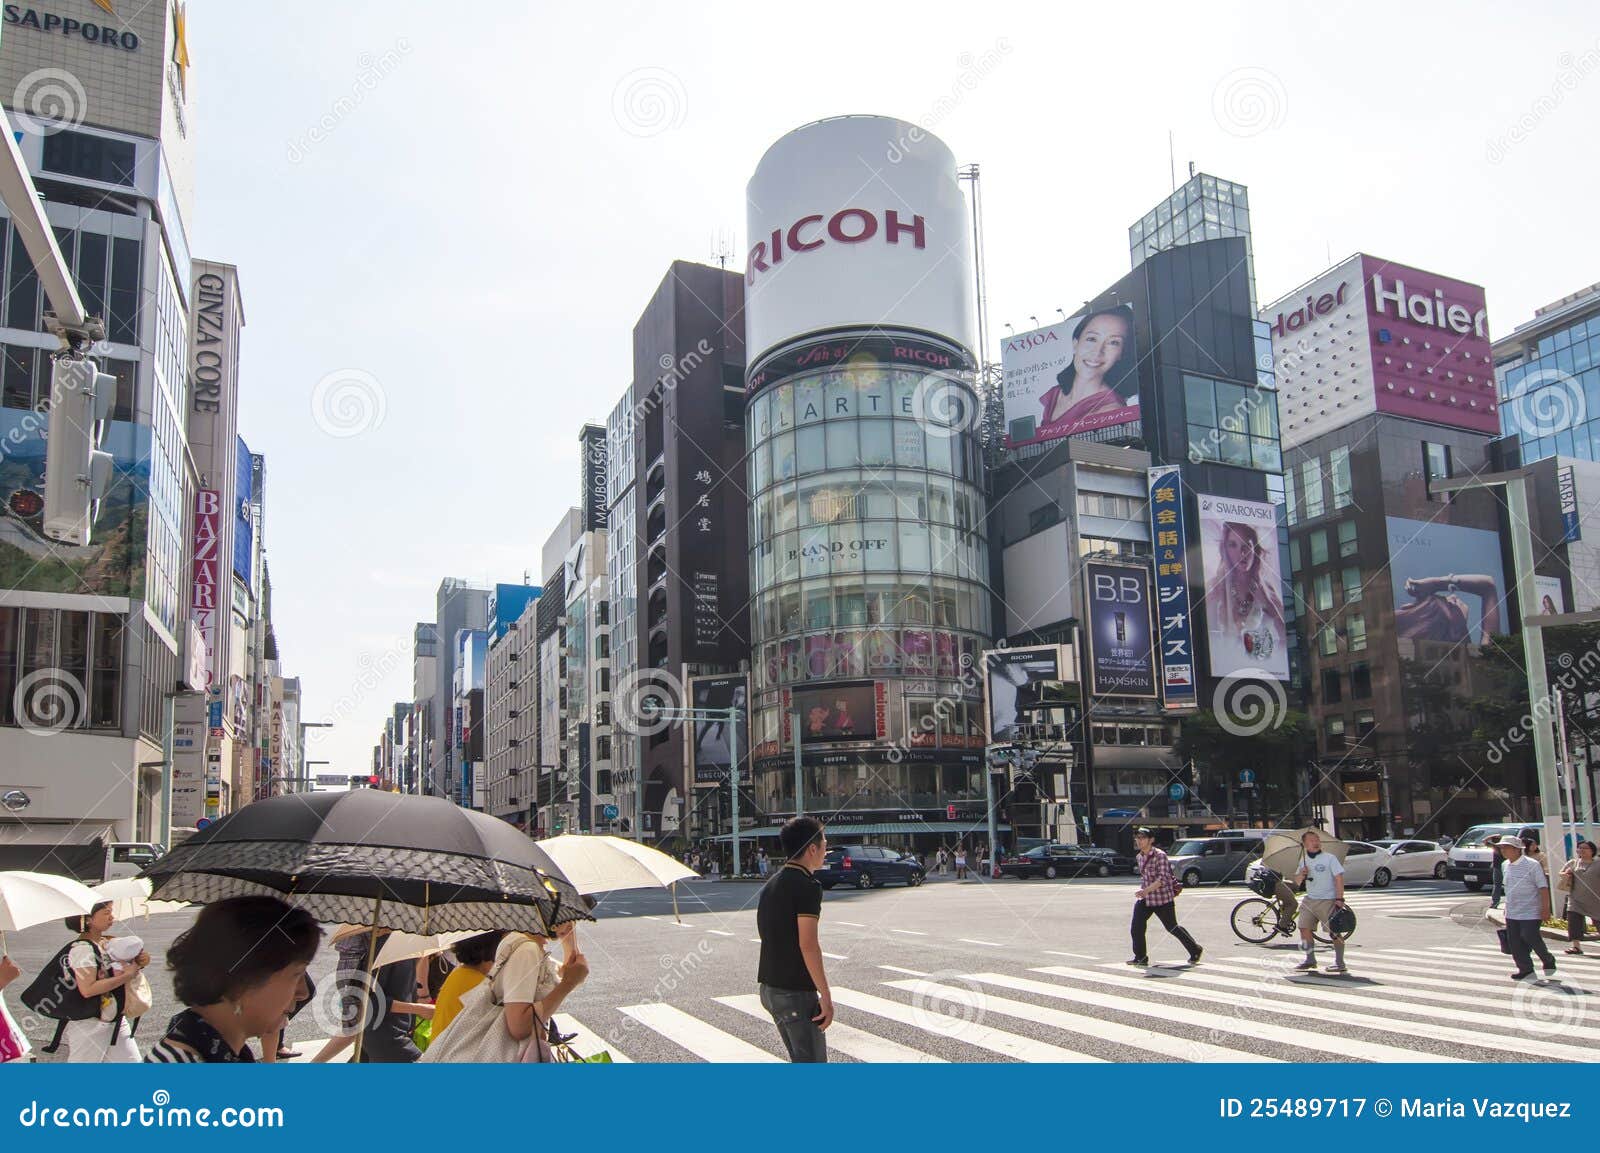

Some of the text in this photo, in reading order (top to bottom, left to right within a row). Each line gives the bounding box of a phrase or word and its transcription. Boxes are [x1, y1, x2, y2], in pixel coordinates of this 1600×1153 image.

[3, 4, 139, 51] SAPPORO
[746, 208, 926, 287] RICOH
[1271, 281, 1347, 338] Haier
[1372, 273, 1489, 338] Haier
[194, 273, 225, 414] GINZA CORE
[893, 346, 950, 367] RICOH
[1006, 331, 1058, 353] ARSOA
[595, 437, 607, 524] MAUBOUSSIN
[695, 470, 713, 532] 鳩居堂
[1559, 472, 1576, 510] HABA
[1216, 502, 1272, 520] SWAROVSKI
[194, 491, 219, 608] BAZAR
[788, 538, 888, 561] BRAND OFF
[1094, 573, 1142, 604] B.B
[1160, 585, 1188, 656] ジオス
[1099, 676, 1149, 687] HANSKIN
